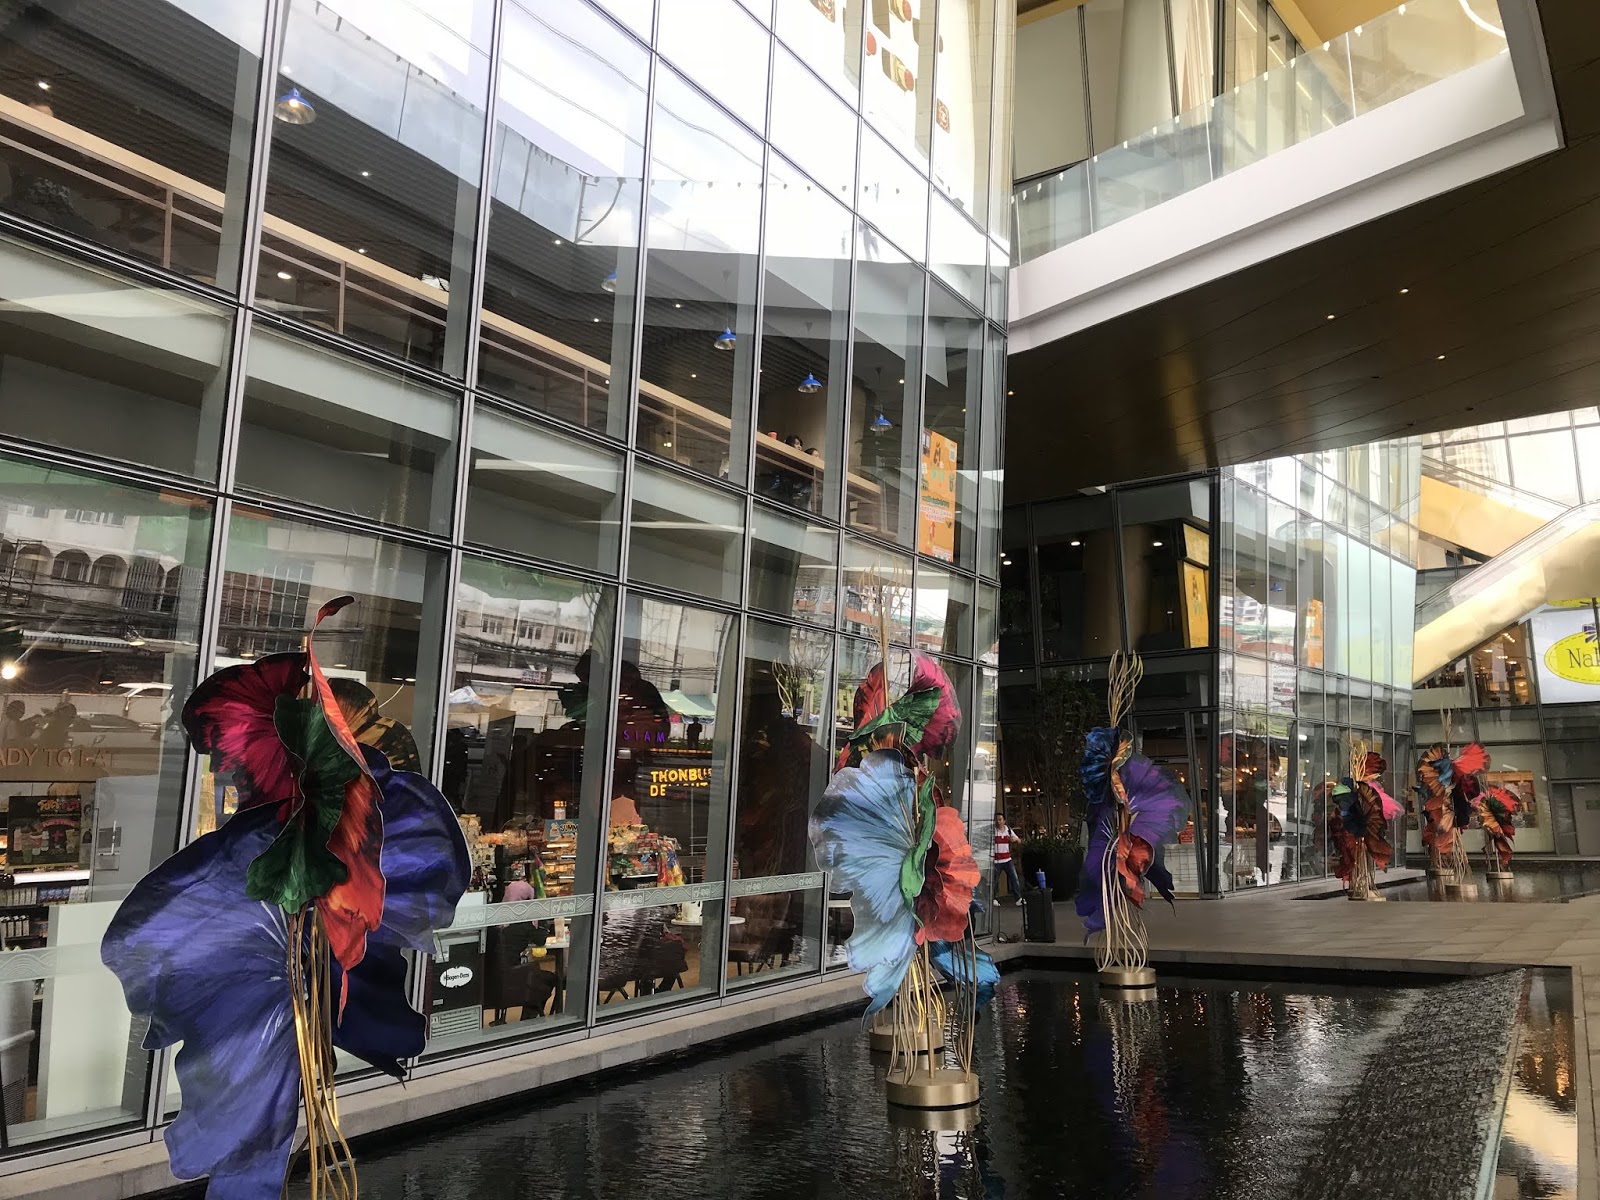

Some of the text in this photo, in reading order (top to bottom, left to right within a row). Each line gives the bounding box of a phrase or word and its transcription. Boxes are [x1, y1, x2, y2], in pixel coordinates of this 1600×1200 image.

[1566, 647, 1600, 669] Na
[623, 731, 665, 742] SIAM
[43, 748, 73, 767] TO
